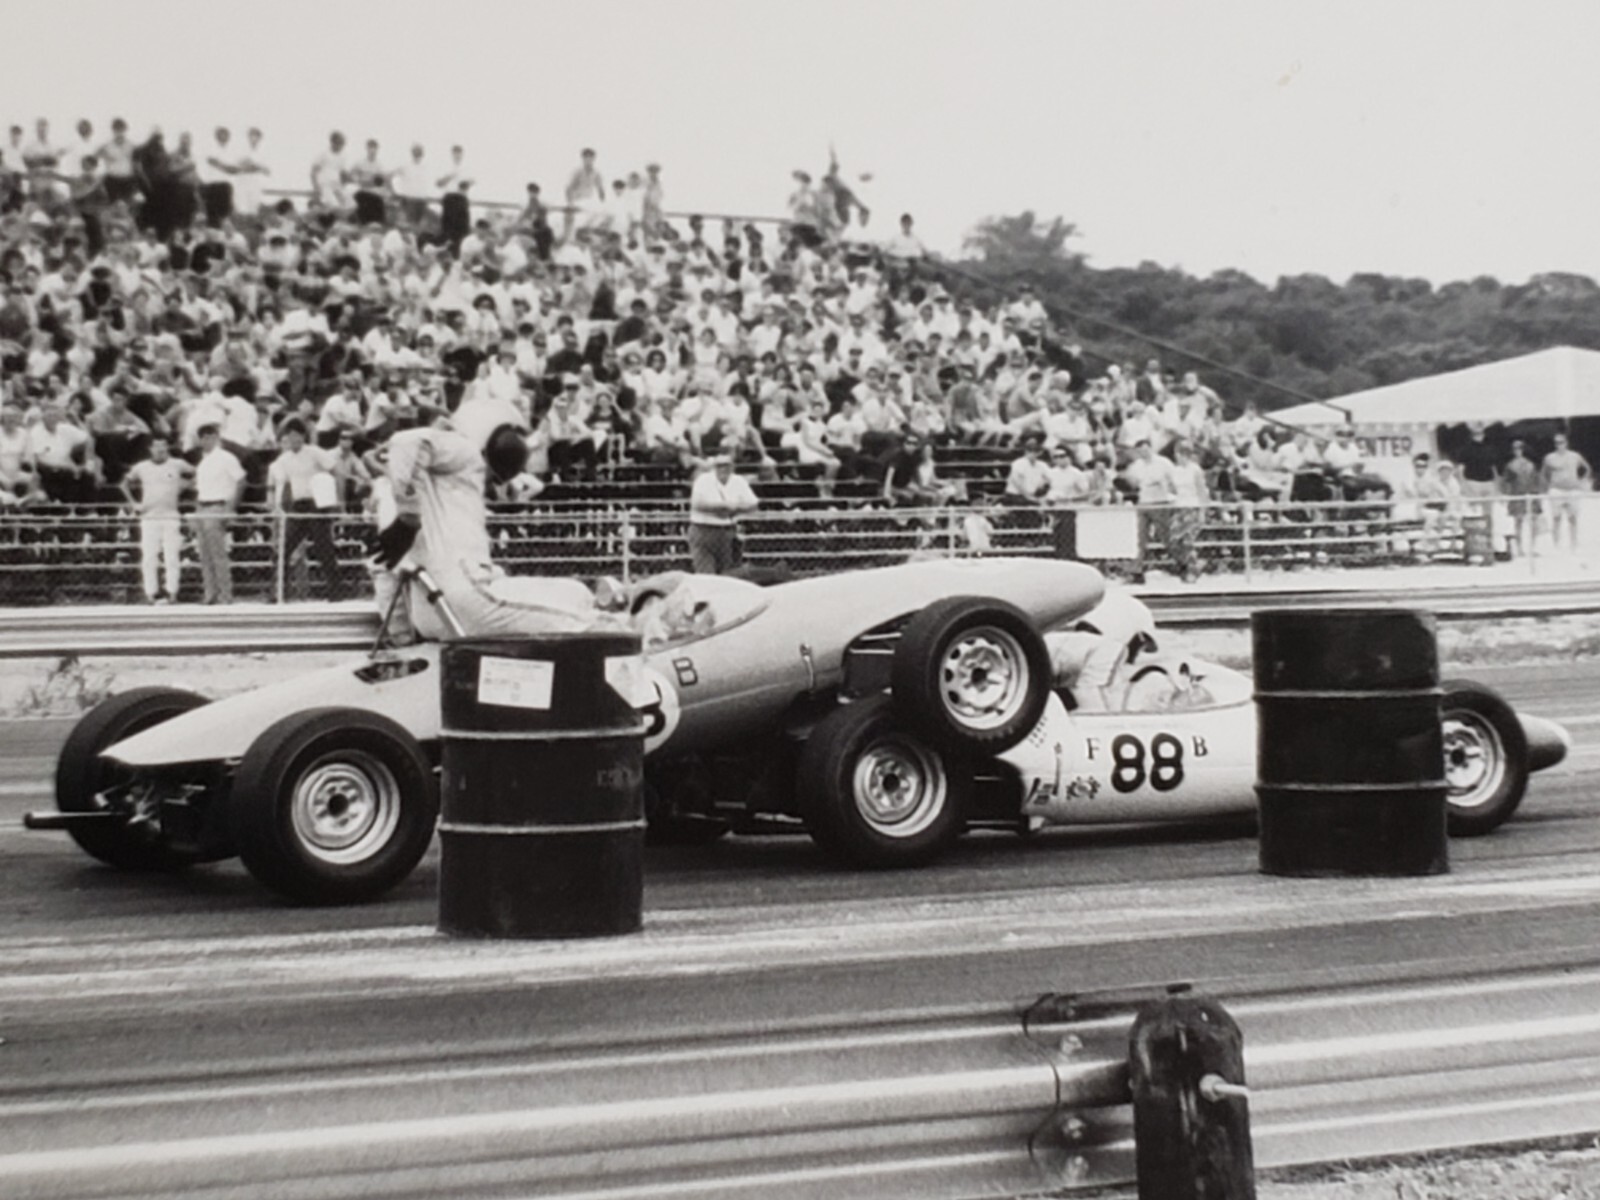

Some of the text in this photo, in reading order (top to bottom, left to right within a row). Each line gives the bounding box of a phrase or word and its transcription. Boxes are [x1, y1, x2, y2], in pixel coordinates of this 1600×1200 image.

[672, 657, 698, 687] B
[1087, 732, 1208, 793] F 88 B
